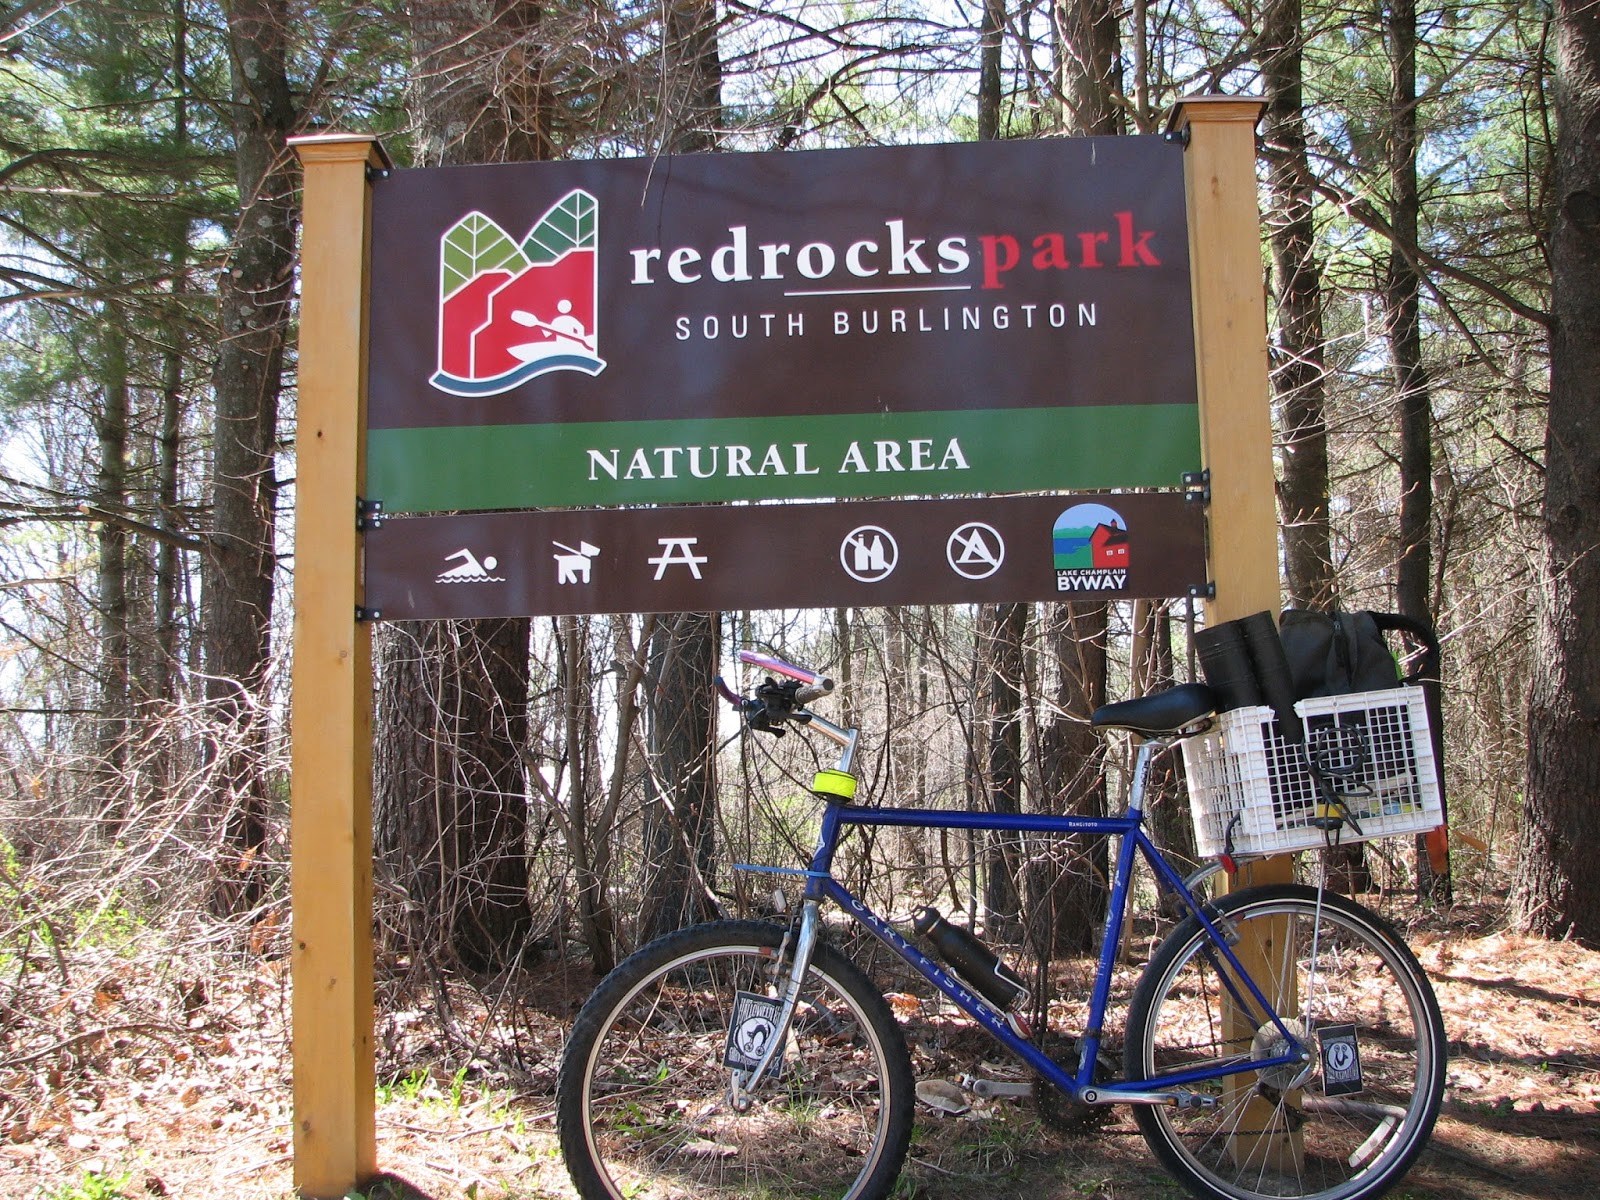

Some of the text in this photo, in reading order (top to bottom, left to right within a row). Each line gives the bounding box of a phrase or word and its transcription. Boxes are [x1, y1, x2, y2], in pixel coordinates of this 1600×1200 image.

[675, 303, 1097, 341] SOUTH BURLINGTON
[587, 437, 970, 482] NATURAL AREA
[1057, 575, 1127, 591] BYWAY
[1080, 568, 1126, 576] CHAMPLAIN
[851, 899, 1004, 1029] GARY FISHER
